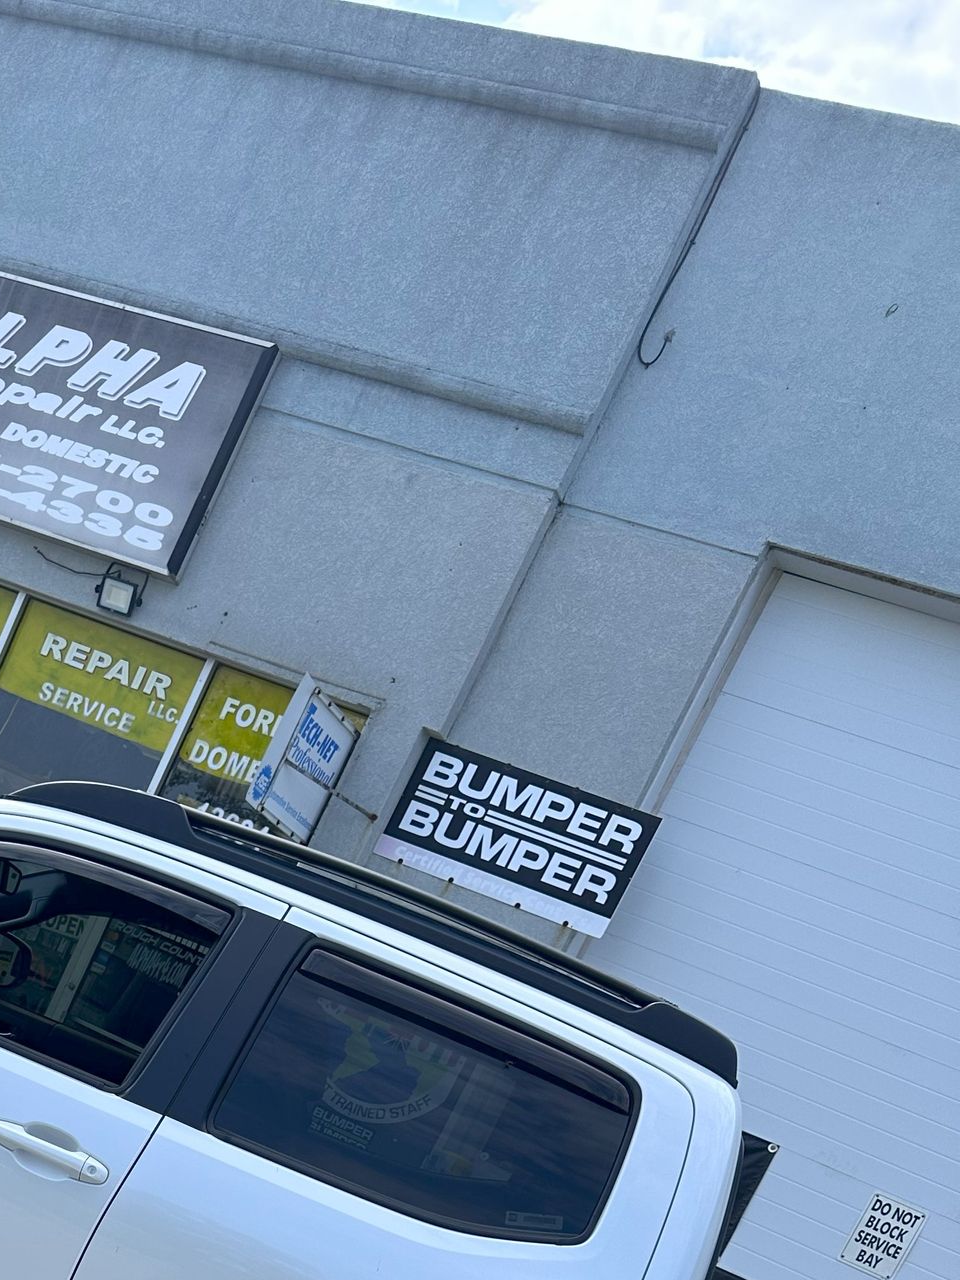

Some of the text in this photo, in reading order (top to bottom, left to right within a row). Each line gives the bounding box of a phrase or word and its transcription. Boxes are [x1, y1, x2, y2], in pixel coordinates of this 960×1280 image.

[0, 421, 160, 484] DOMESTIC
[39, 632, 173, 701] REPAIR
[38, 681, 137, 734] SERVICE
[289, 737, 336, 786] Professional
[422, 750, 643, 855] BUMPER
[448, 794, 487, 819] TO
[397, 799, 618, 905] BUMPER
[312, 1105, 374, 1141] BUMPER
[329, 1091, 433, 1120] TRAINED STAFF
[865, 1214, 910, 1244] BLOCK
[870, 1198, 921, 1229] DO NOT
[854, 1229, 903, 1260] SERVICE
[855, 1249, 884, 1270] BAY
